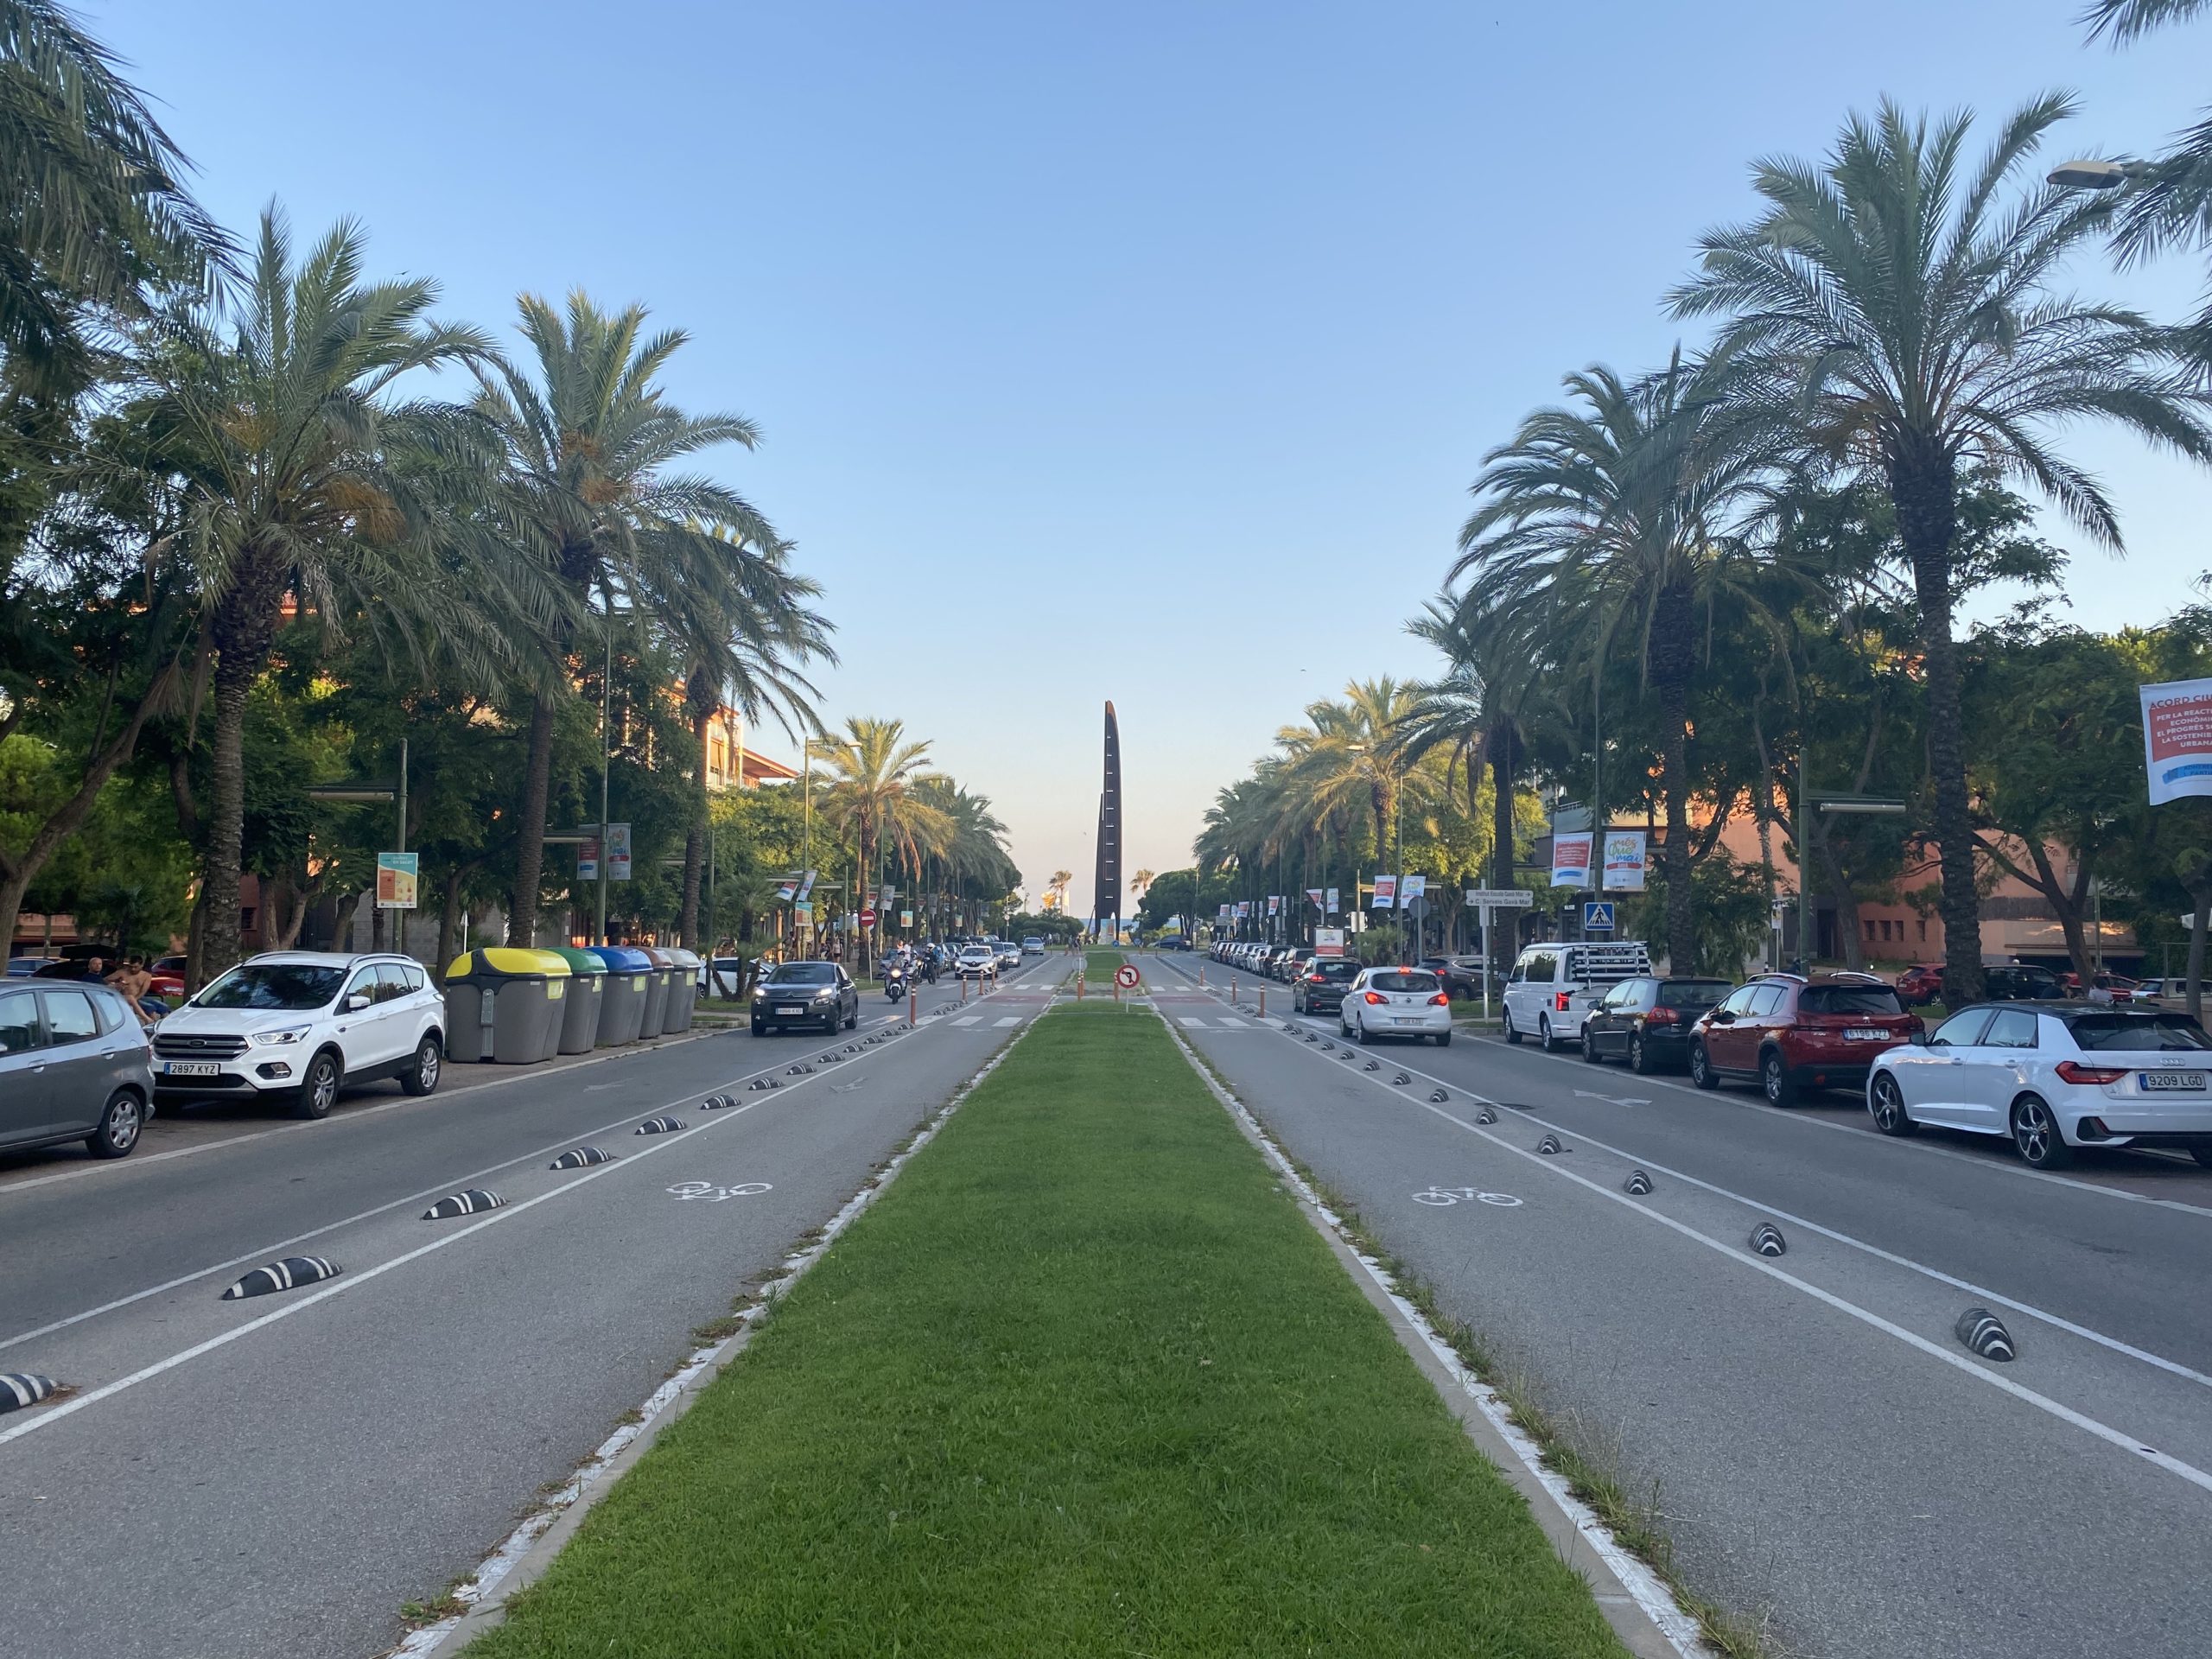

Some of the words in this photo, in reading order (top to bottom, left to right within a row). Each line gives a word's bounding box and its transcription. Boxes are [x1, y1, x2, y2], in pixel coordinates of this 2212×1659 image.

[2151, 696, 2190, 709] ACORD
[171, 1065, 194, 1074] 2897
[197, 1065, 216, 1074] KYZ
[2149, 1076, 2177, 1086] 9209
[2180, 1076, 2202, 1086] LGD
